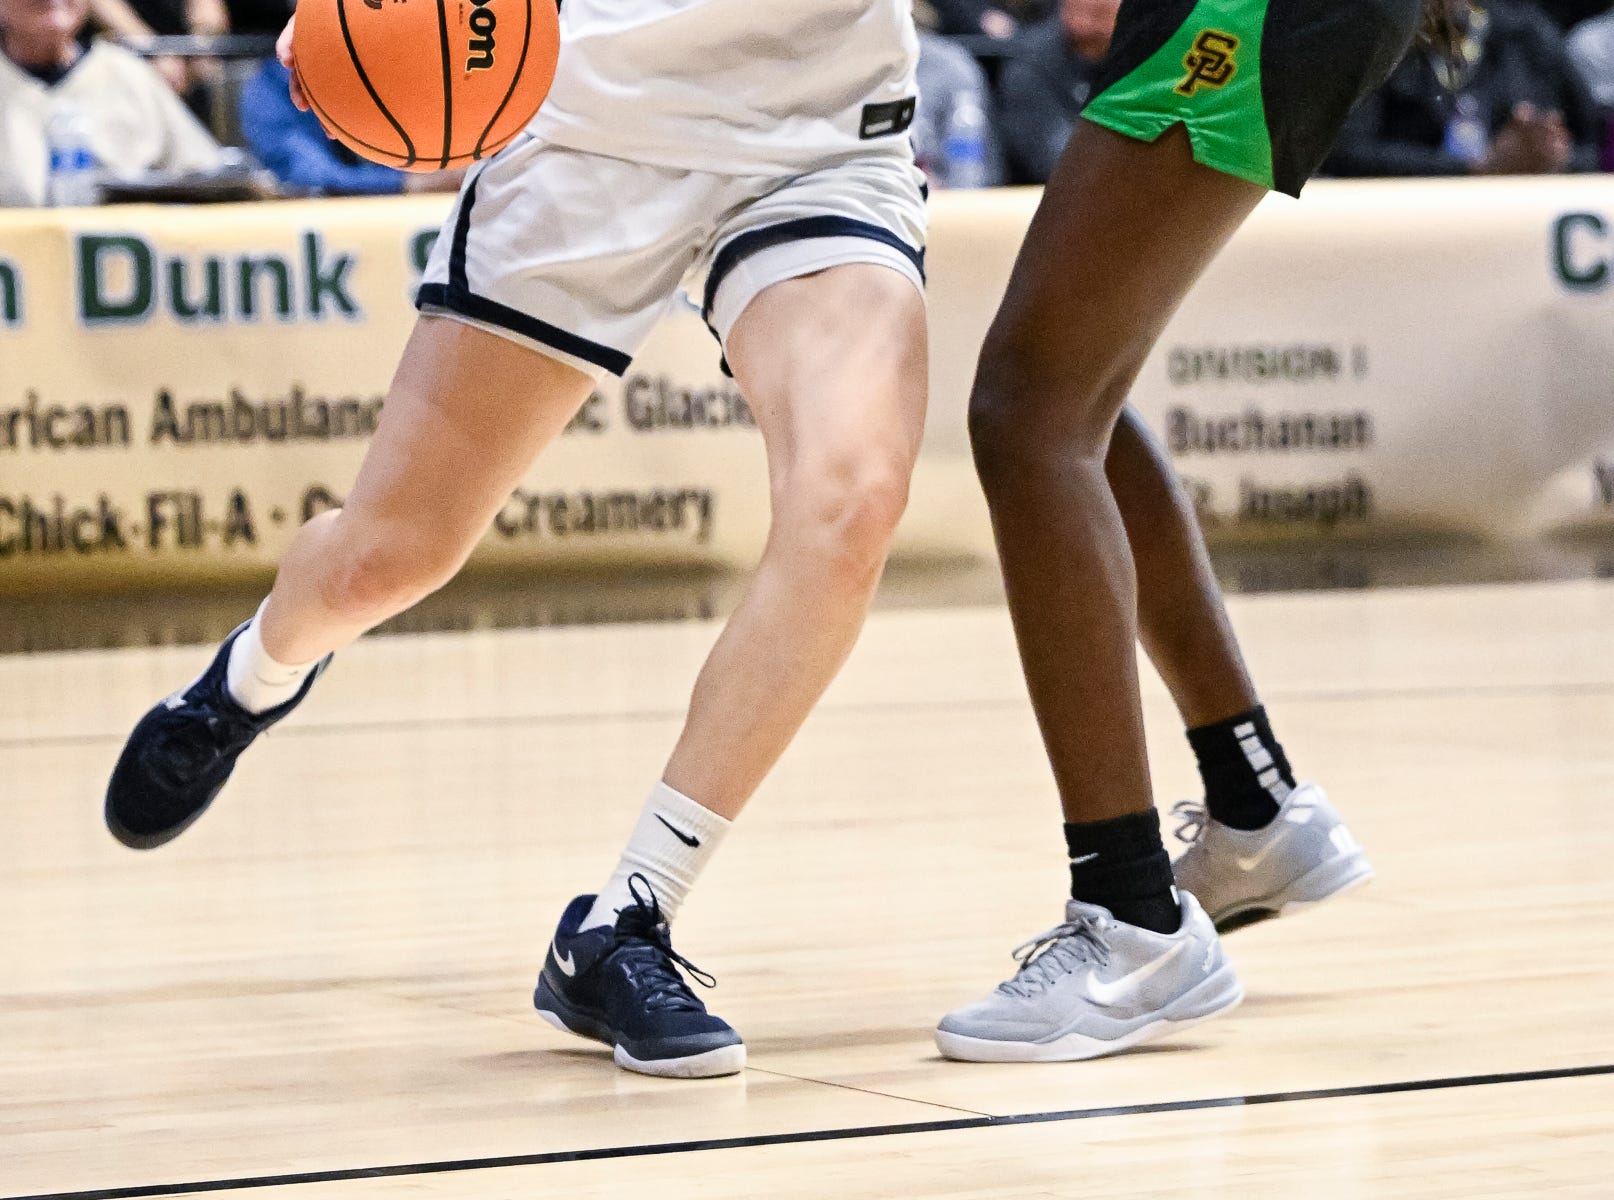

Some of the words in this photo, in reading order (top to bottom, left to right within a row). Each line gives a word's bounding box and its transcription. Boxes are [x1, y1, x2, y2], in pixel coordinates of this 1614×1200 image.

[77, 229, 360, 322] Dunk
[1167, 344, 1341, 385] DIVISION
[1167, 404, 1374, 454] Buchanan
[496, 488, 714, 543] Creamery
